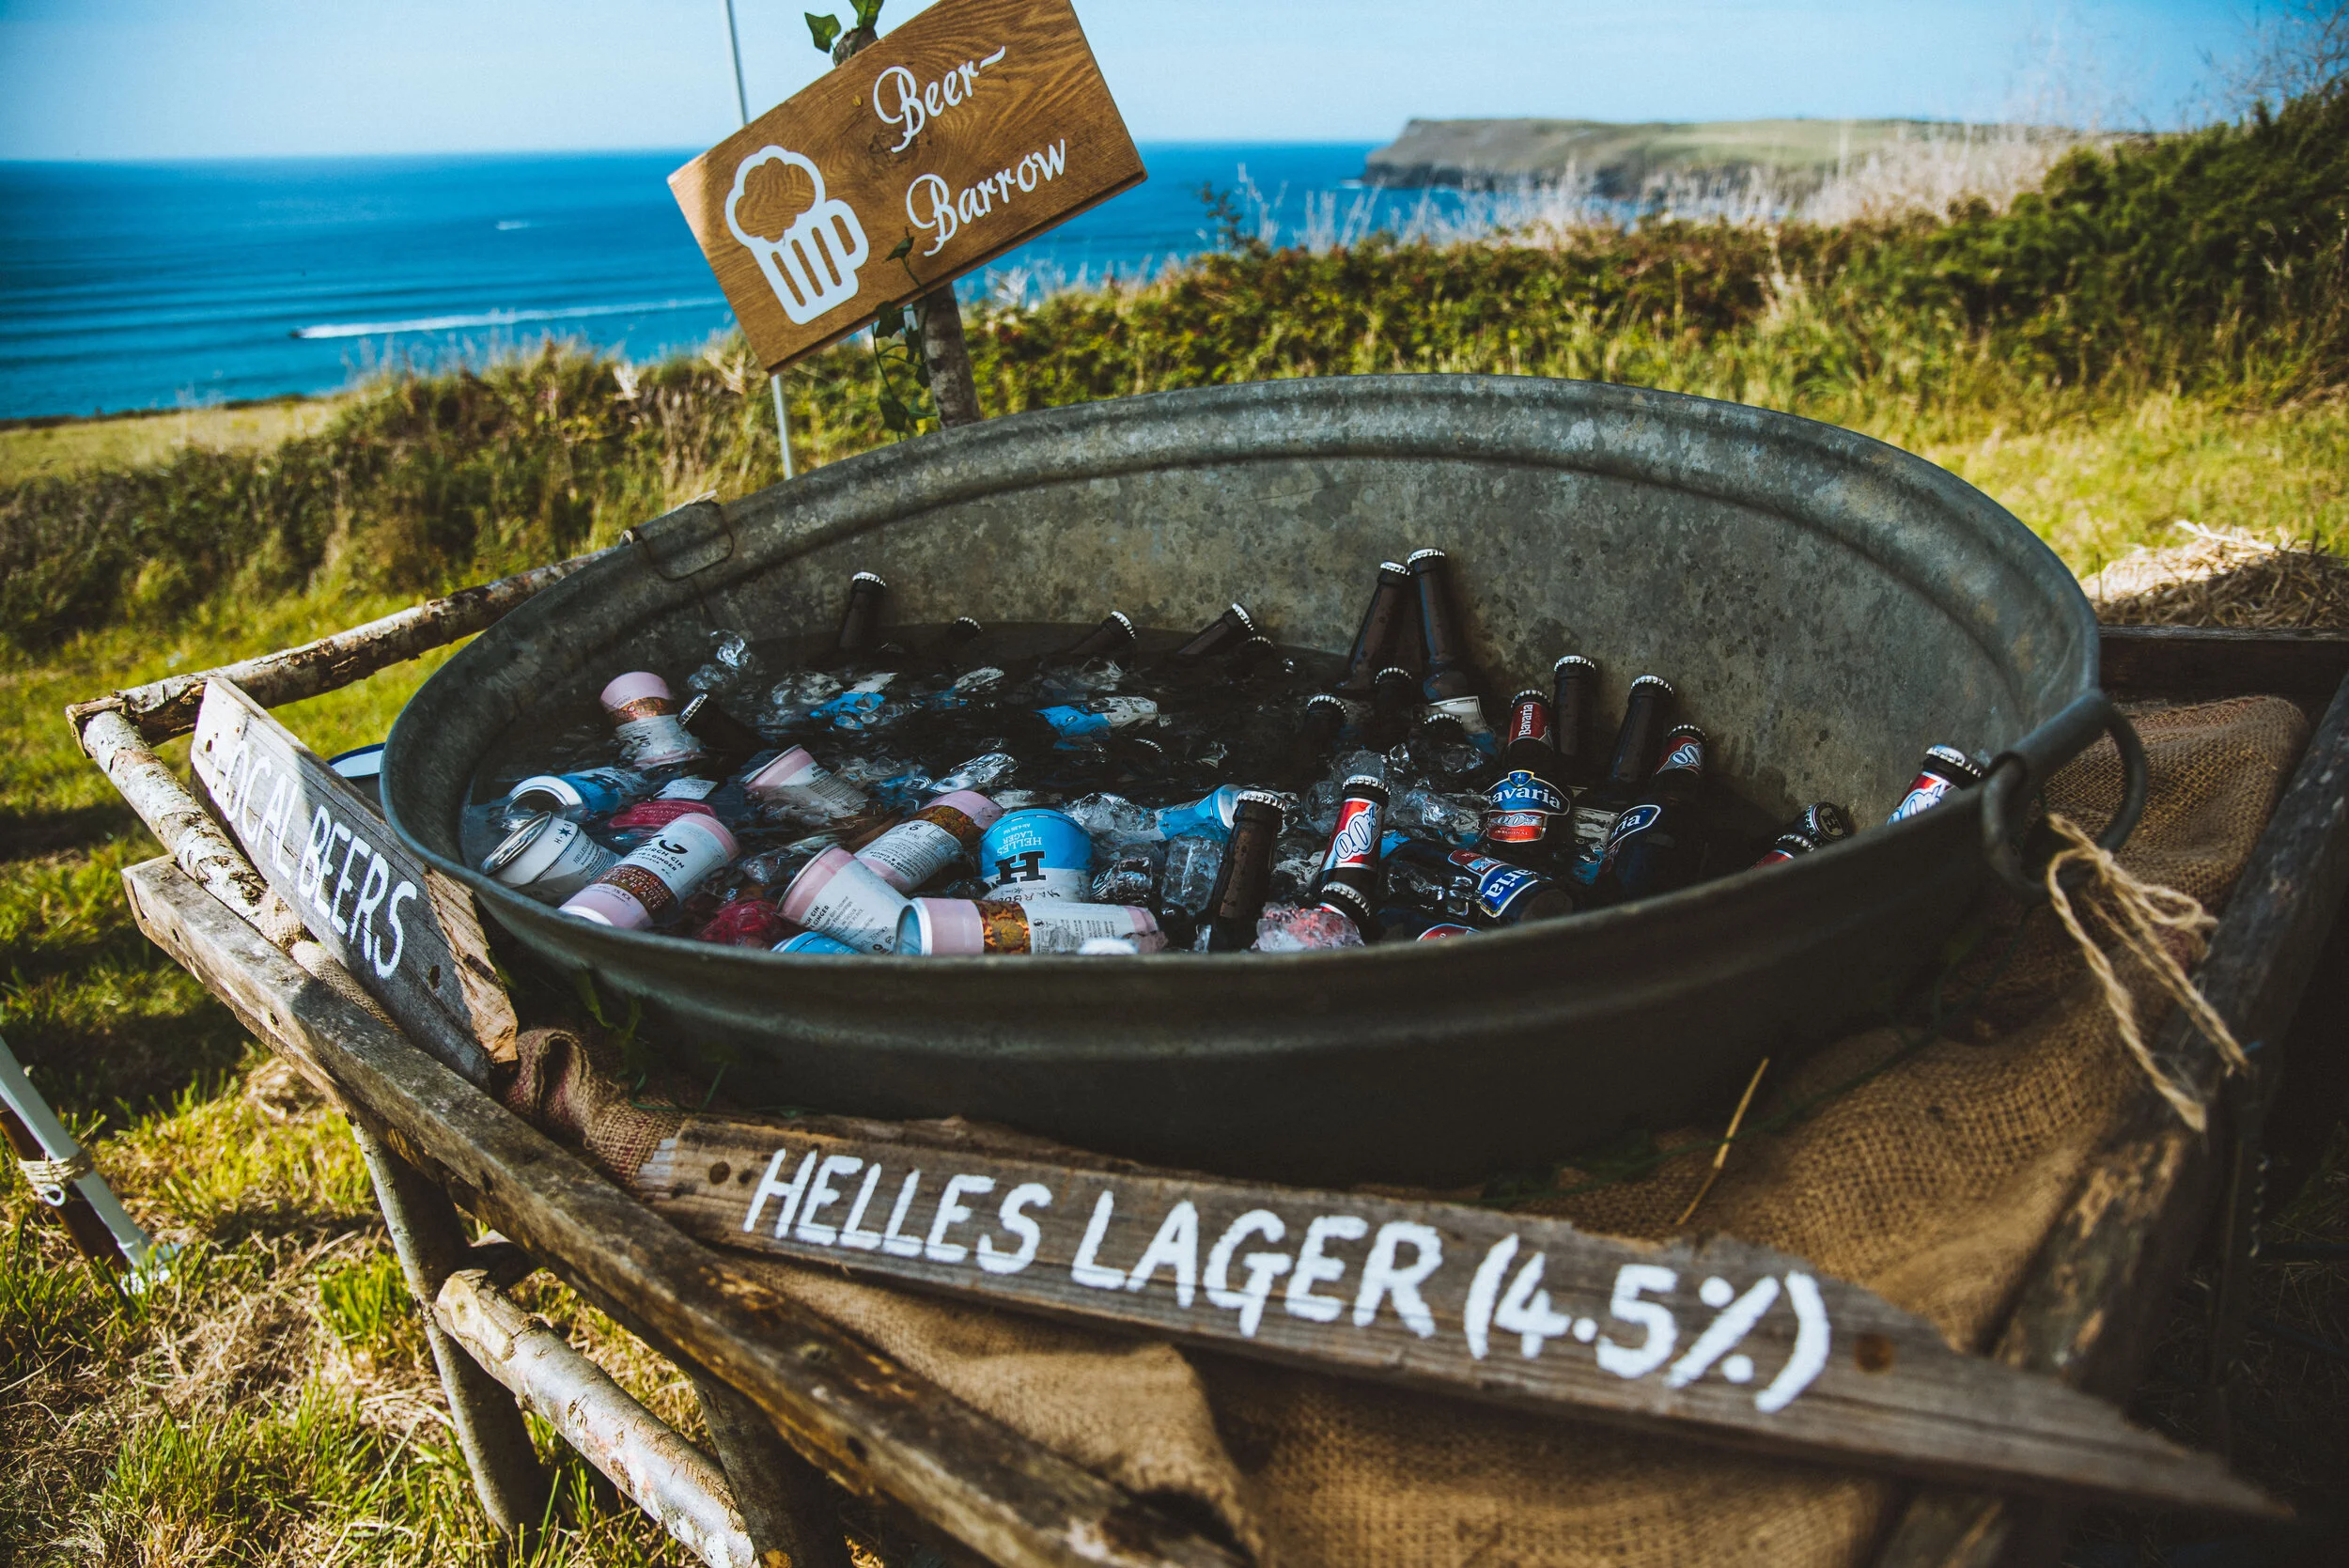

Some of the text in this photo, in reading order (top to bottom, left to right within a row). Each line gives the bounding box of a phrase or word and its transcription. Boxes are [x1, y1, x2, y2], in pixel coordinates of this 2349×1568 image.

[906, 138, 1066, 257] Barrow
[1518, 704, 1533, 737] Bavaria
[1491, 787, 1561, 810] avaria
[1003, 830, 1034, 845] LAGER
[1335, 806, 1377, 860] 0.0%
[997, 837, 1042, 857] HELLES
[209, 740, 418, 980] LOCAL BEERS
[651, 853, 677, 872] GINGER
[670, 855, 685, 869] GIN
[811, 906, 820, 917] GIN
[813, 905, 831, 925] GINGER
[743, 1148, 1830, 1410] HELLES LAGER (4.5%)
